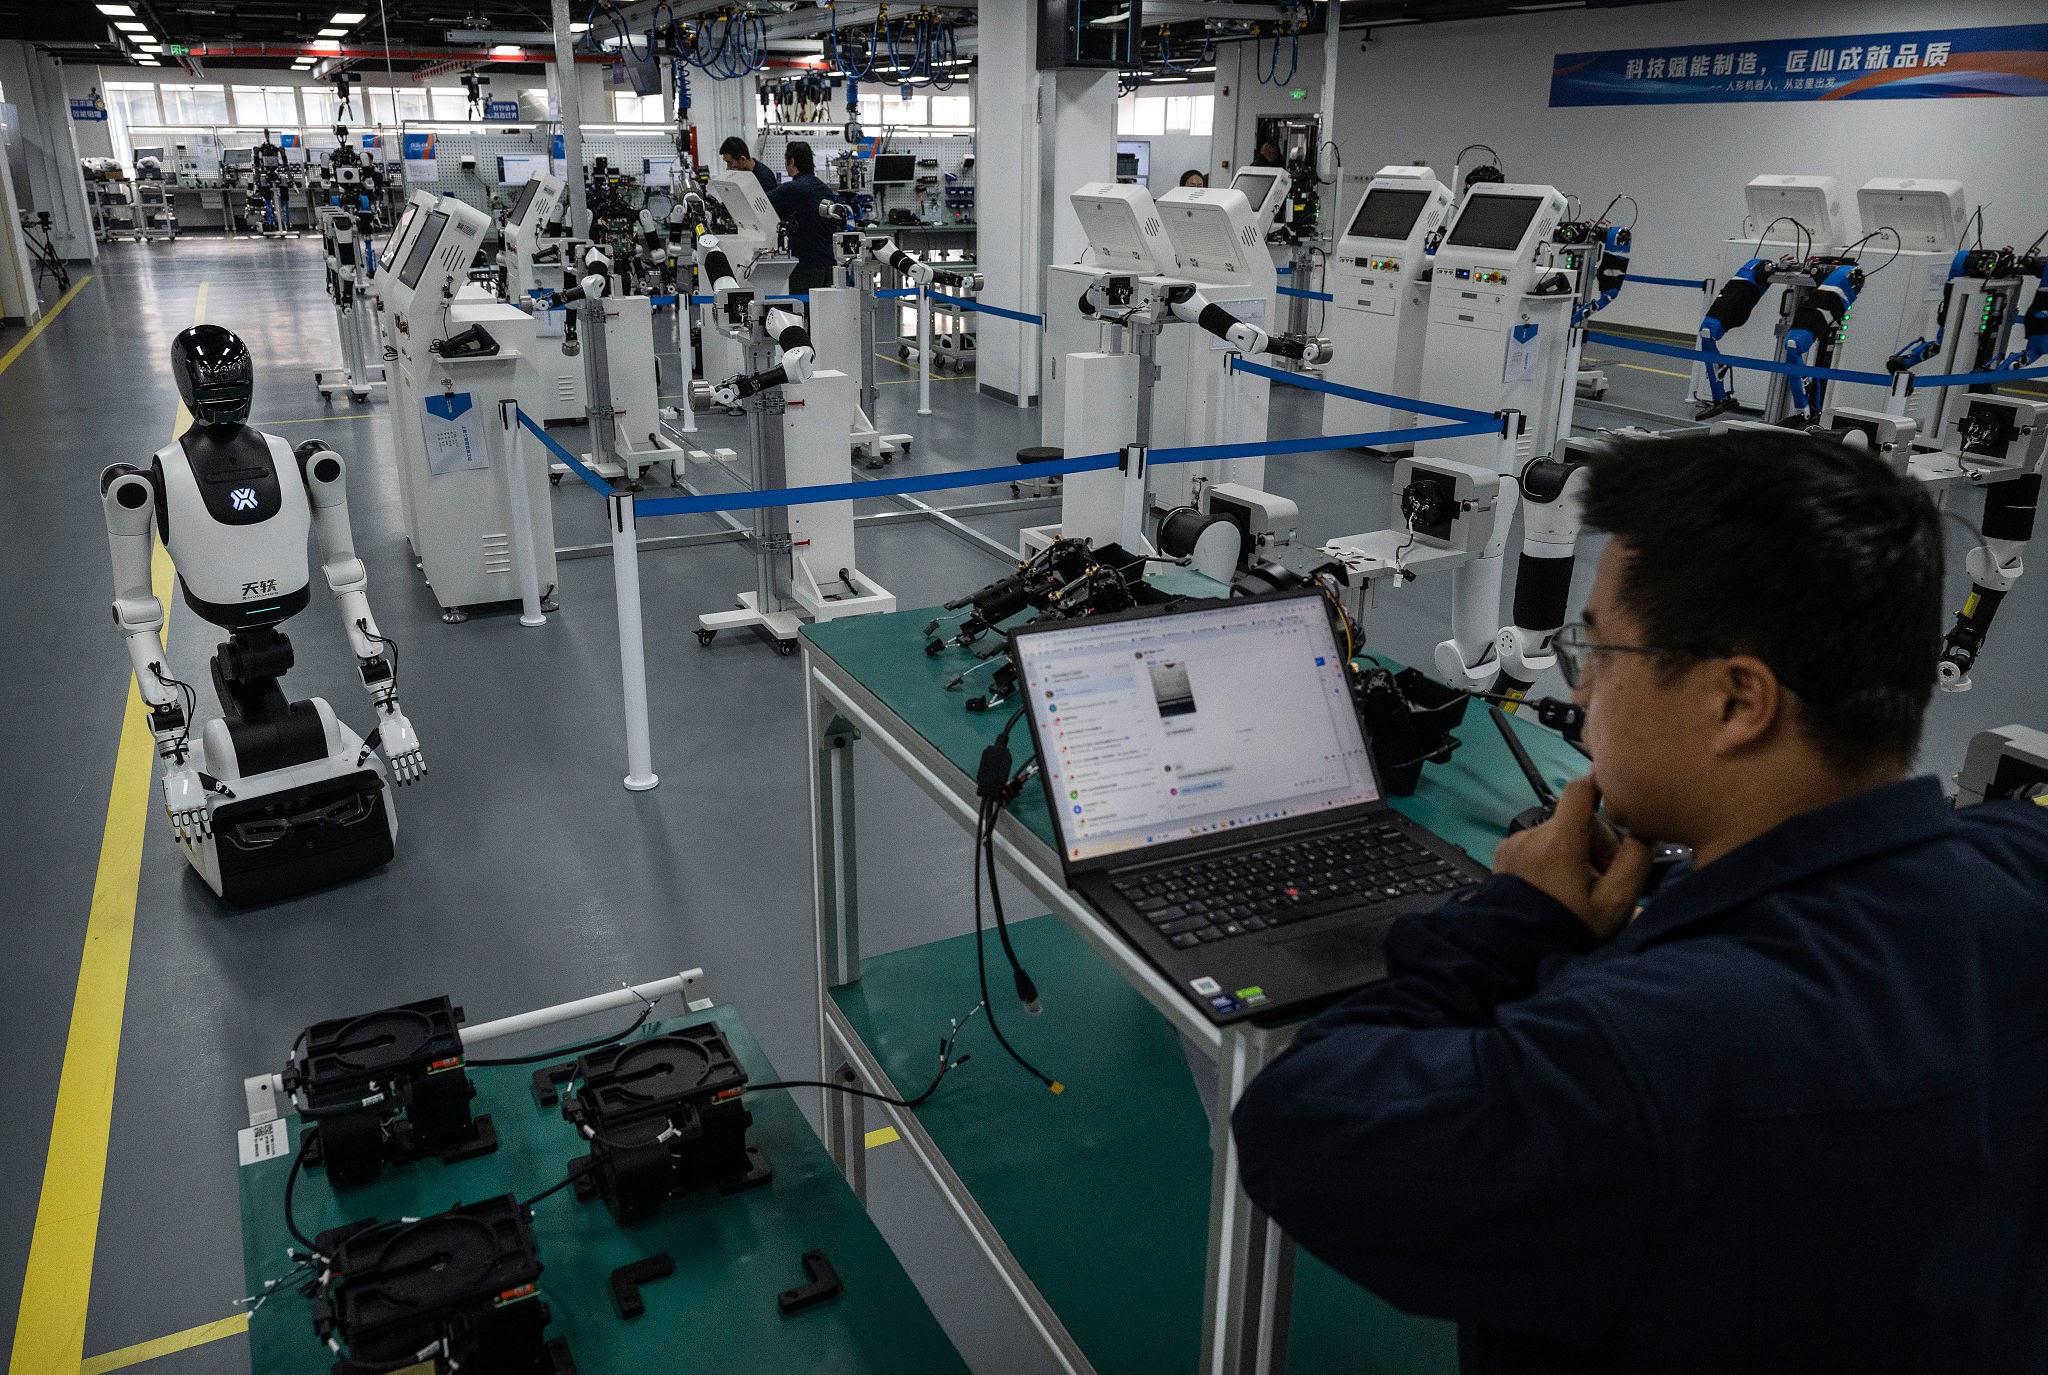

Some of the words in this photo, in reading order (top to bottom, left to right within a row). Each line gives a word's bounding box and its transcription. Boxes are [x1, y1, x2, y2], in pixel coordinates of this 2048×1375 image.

[1624, 42, 1951, 80] 科技赋能制造，匠心成就品质
